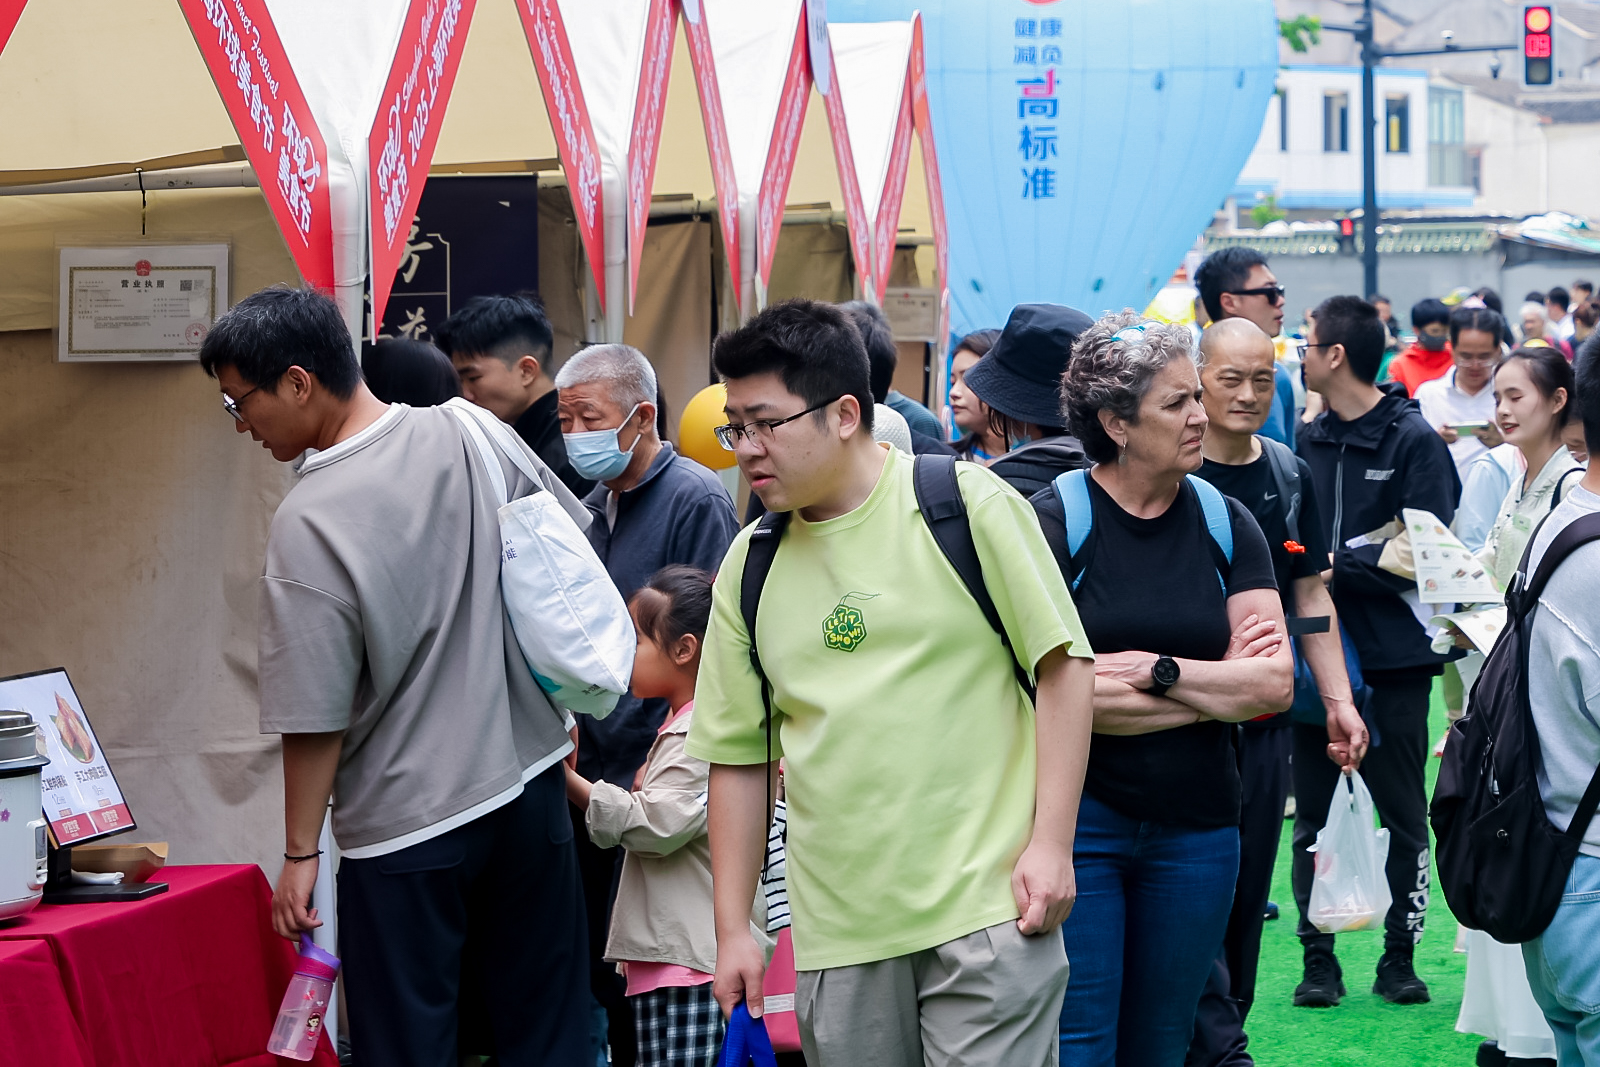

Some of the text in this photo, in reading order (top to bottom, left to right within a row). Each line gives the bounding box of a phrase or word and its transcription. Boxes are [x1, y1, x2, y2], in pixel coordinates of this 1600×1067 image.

[1014, 17, 1063, 38] 健康
[1014, 44, 1063, 65] 减负
[250, 28, 279, 100] Festival
[282, 101, 310, 175] 环球
[408, 88, 429, 168] 2025
[1016, 67, 1060, 200] 高标准
[277, 146, 312, 234] 美食节
[121, 280, 165, 289] 营业执照
[828, 613, 856, 629] LET IT
